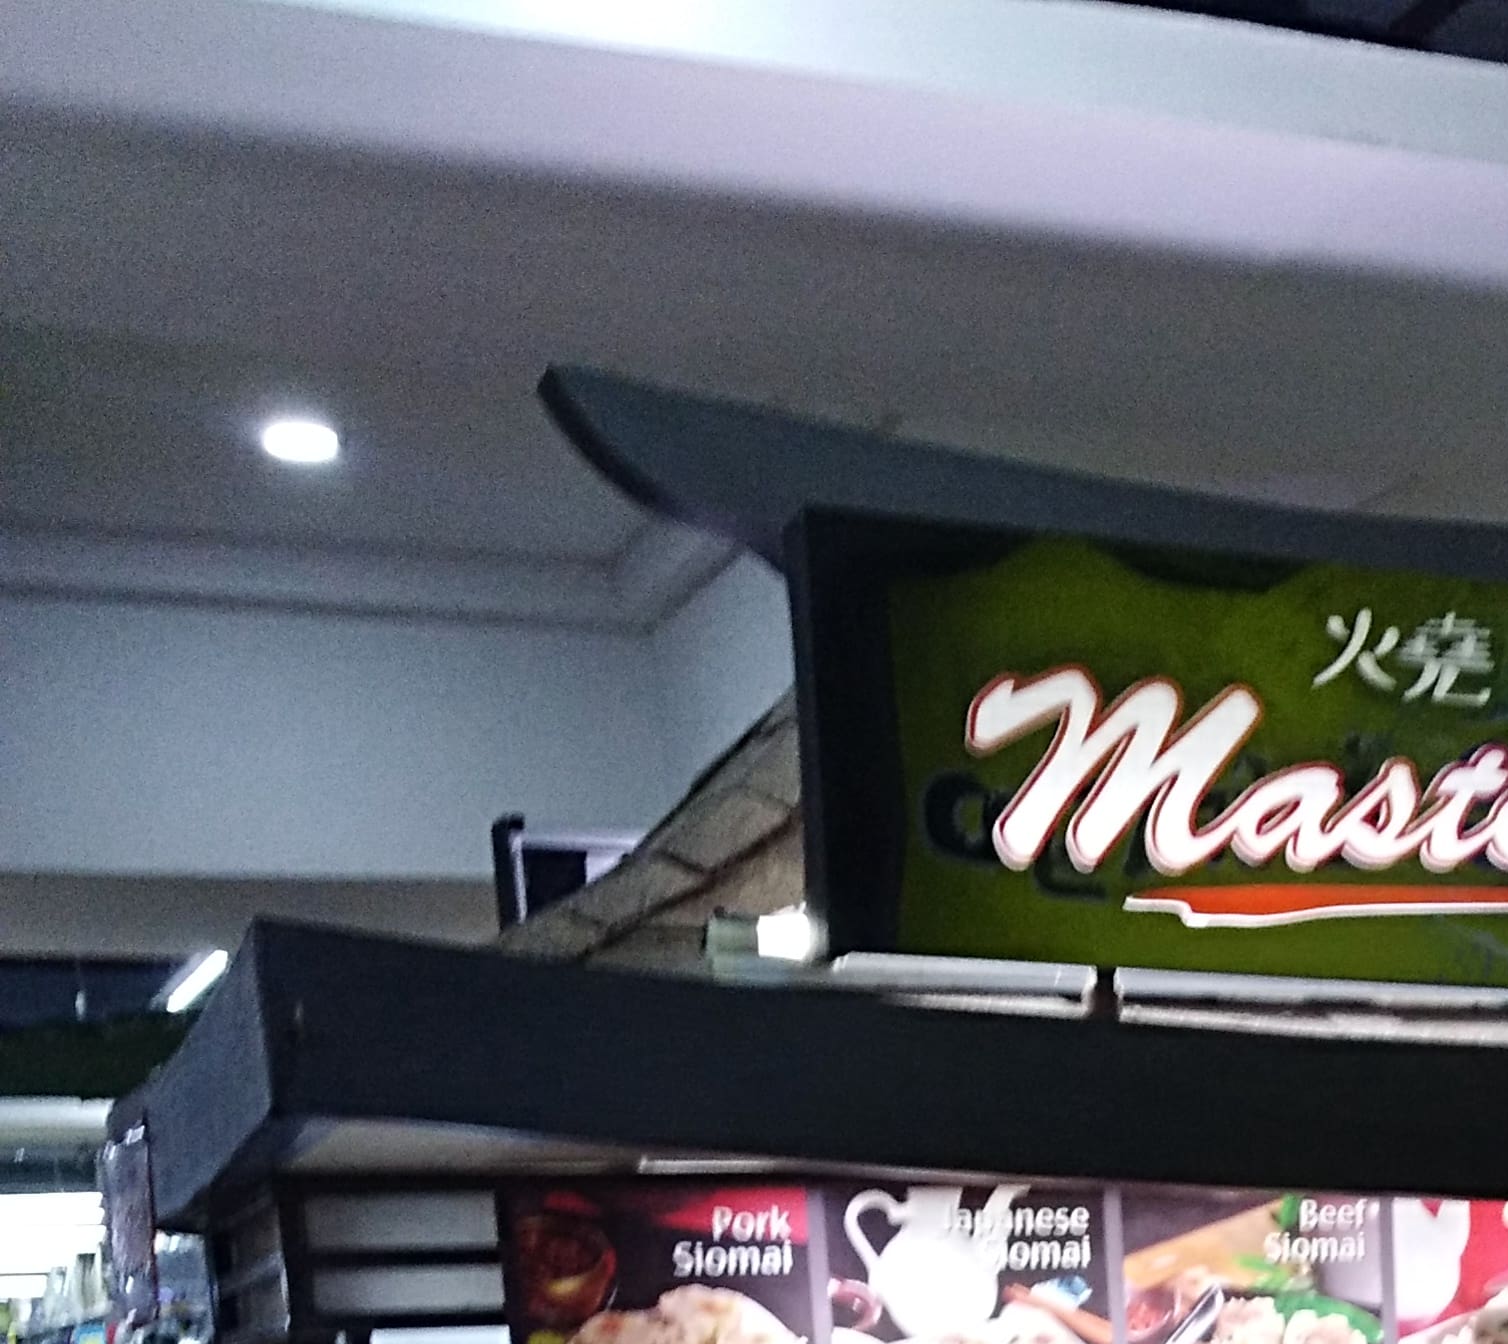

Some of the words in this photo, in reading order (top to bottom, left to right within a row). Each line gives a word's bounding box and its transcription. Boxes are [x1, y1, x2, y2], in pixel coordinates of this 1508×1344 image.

[712, 1205, 792, 1244] Pork
[1300, 1200, 1367, 1229] Beef
[673, 1241, 794, 1278] Siomai
[1264, 1230, 1366, 1262] Siomai
